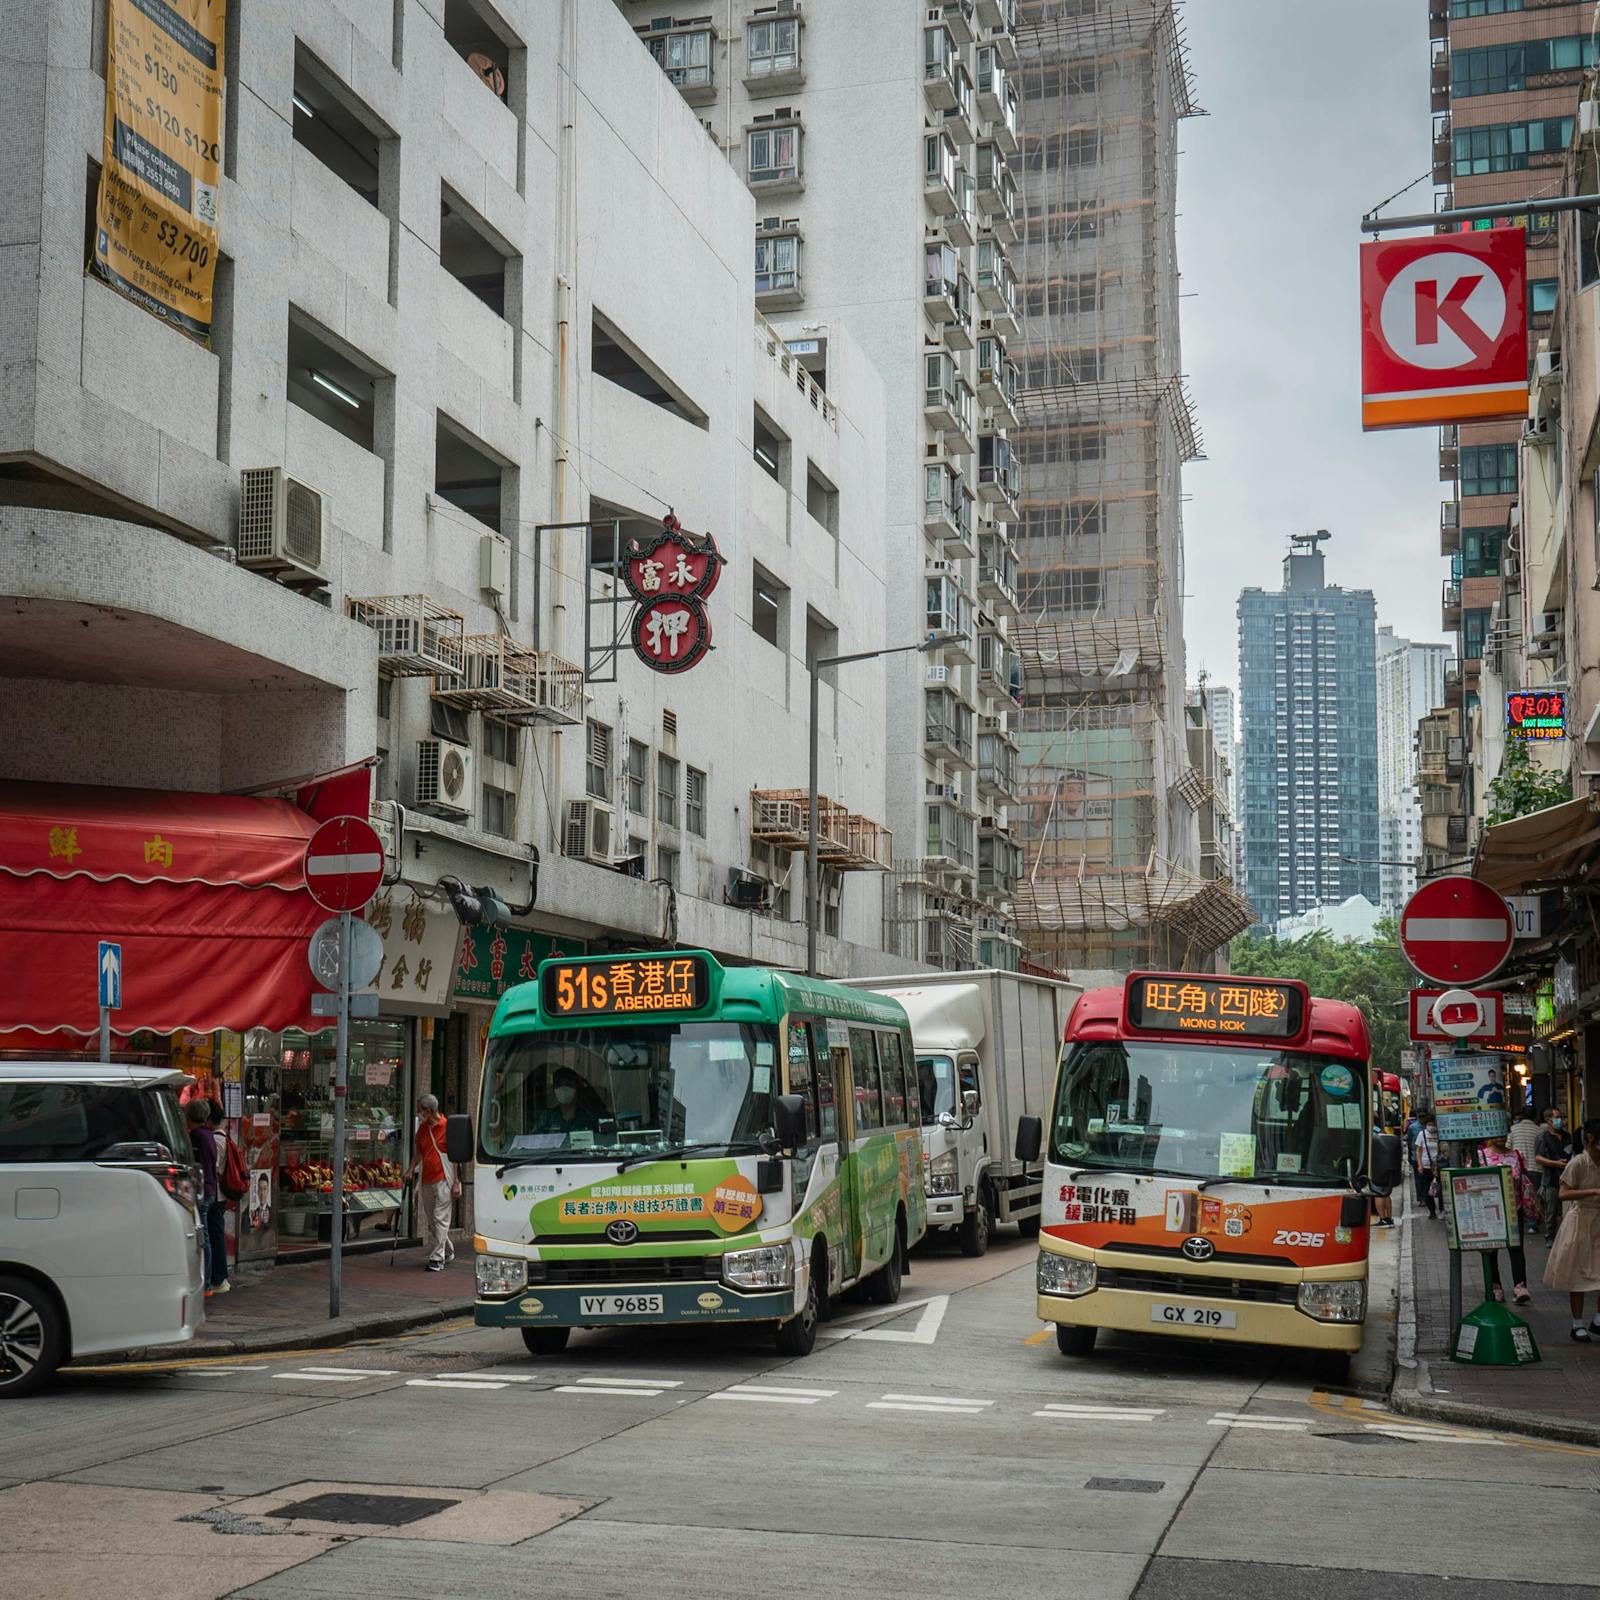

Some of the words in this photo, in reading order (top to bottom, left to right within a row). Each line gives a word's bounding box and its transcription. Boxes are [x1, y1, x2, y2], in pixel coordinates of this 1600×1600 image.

[144, 53, 178, 96] $130
[146, 97, 180, 138] $120
[184, 127, 221, 164] $120
[126, 132, 150, 158] Please
[150, 153, 178, 180] contact
[146, 165, 163, 186] 2553
[108, 171, 141, 202] Monthly
[105, 191, 134, 221] Parking
[141, 203, 158, 222] from
[156, 219, 209, 268] $3,700
[113, 240, 128, 257] Kam
[128, 250, 145, 270] Fung
[145, 261, 175, 288] Building
[173, 279, 204, 301] Carpark
[1415, 275, 1495, 358] K
[646, 610, 691, 657] 押
[1523, 696, 1562, 716] 足の家
[1522, 718, 1537, 728] FOOT
[1537, 718, 1563, 728] MASSAGE
[608, 959, 695, 996] 香港仔
[614, 993, 692, 1011] ABERDEEN
[1456, 1006, 1464, 1019] 1
[1180, 1018, 1217, 1030] MONG
[1219, 1019, 1246, 1031] KOK
[563, 1197, 705, 1216] 長者治療小組技巧證書
[713, 1199, 753, 1219] 第三級
[1065, 1203, 1136, 1226] 緩副作用
[1273, 1230, 1326, 1248] 2036
[584, 1298, 606, 1313] VY
[614, 1297, 660, 1312] 9685
[1163, 1307, 1185, 1321] GX
[1194, 1310, 1222, 1325] 219
